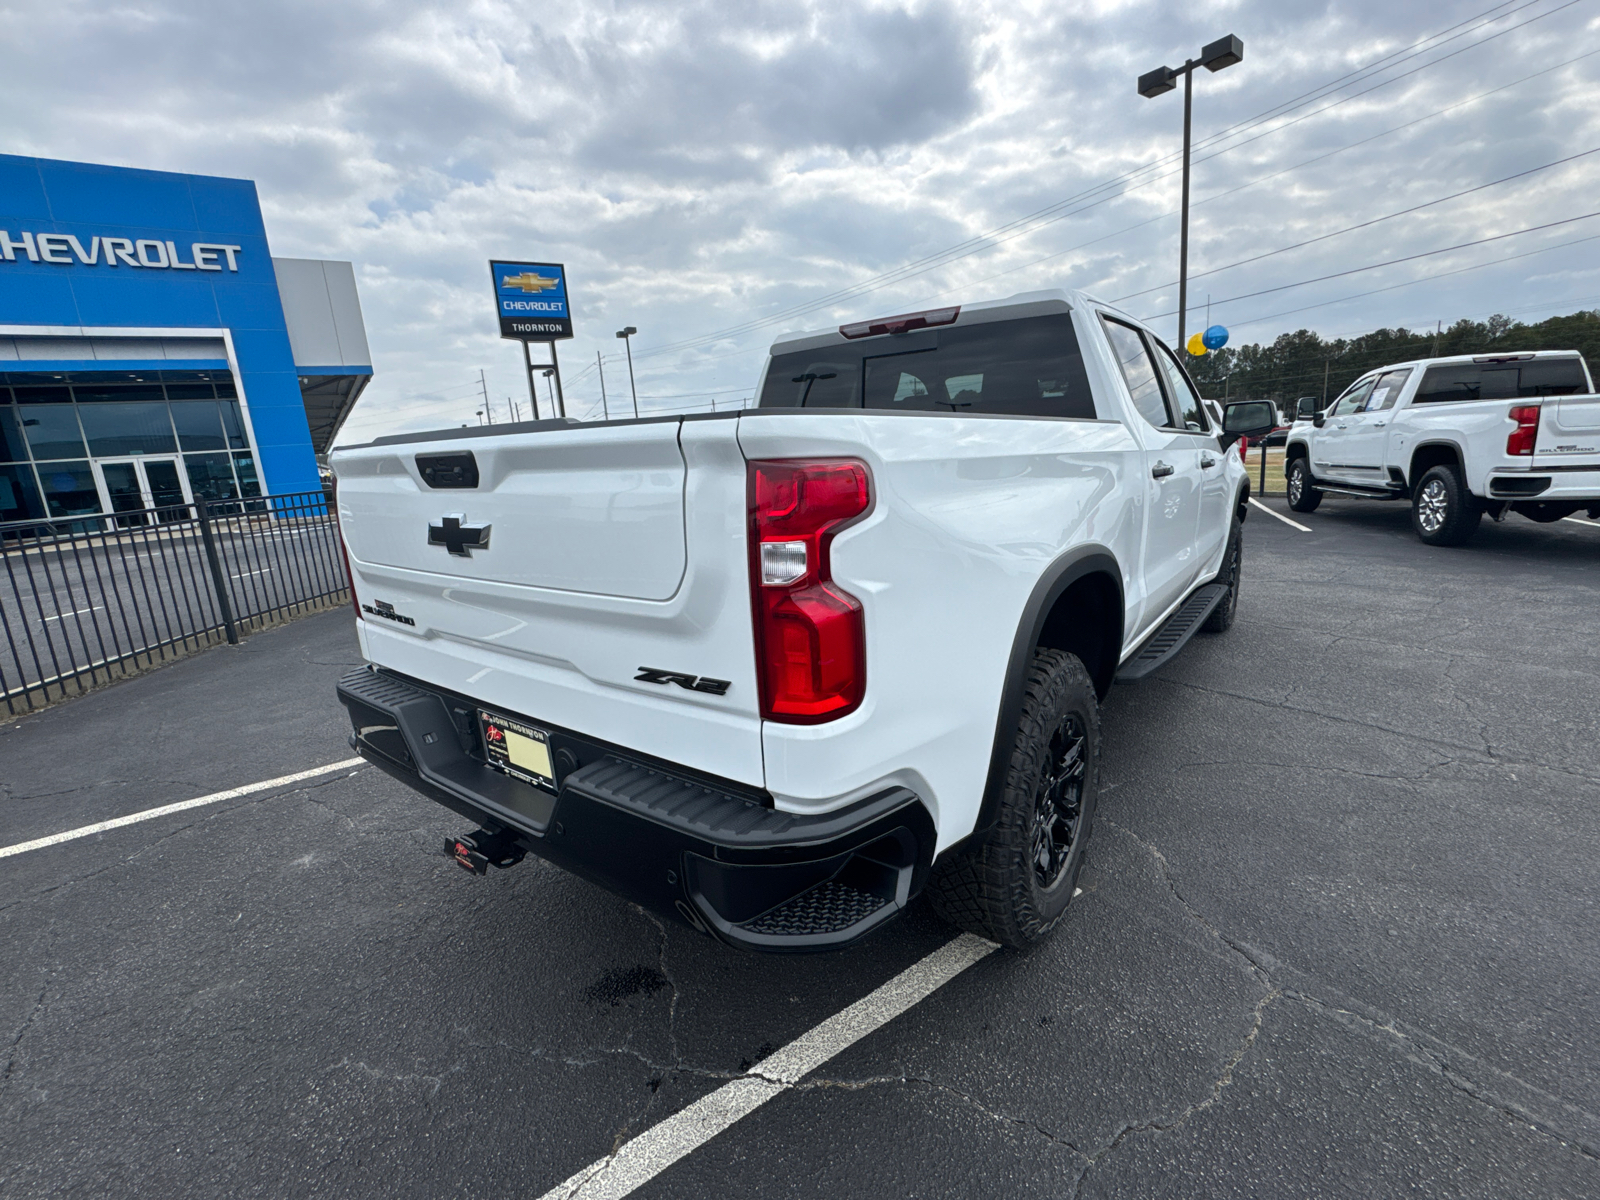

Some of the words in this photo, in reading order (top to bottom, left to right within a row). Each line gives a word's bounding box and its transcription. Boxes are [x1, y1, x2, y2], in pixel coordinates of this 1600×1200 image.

[0, 230, 241, 272] HEVROLET
[503, 301, 563, 311] CHEVROLET
[512, 323, 563, 332] THORNTON
[633, 666, 732, 696] ZR2
[493, 716, 509, 728] JOHN
